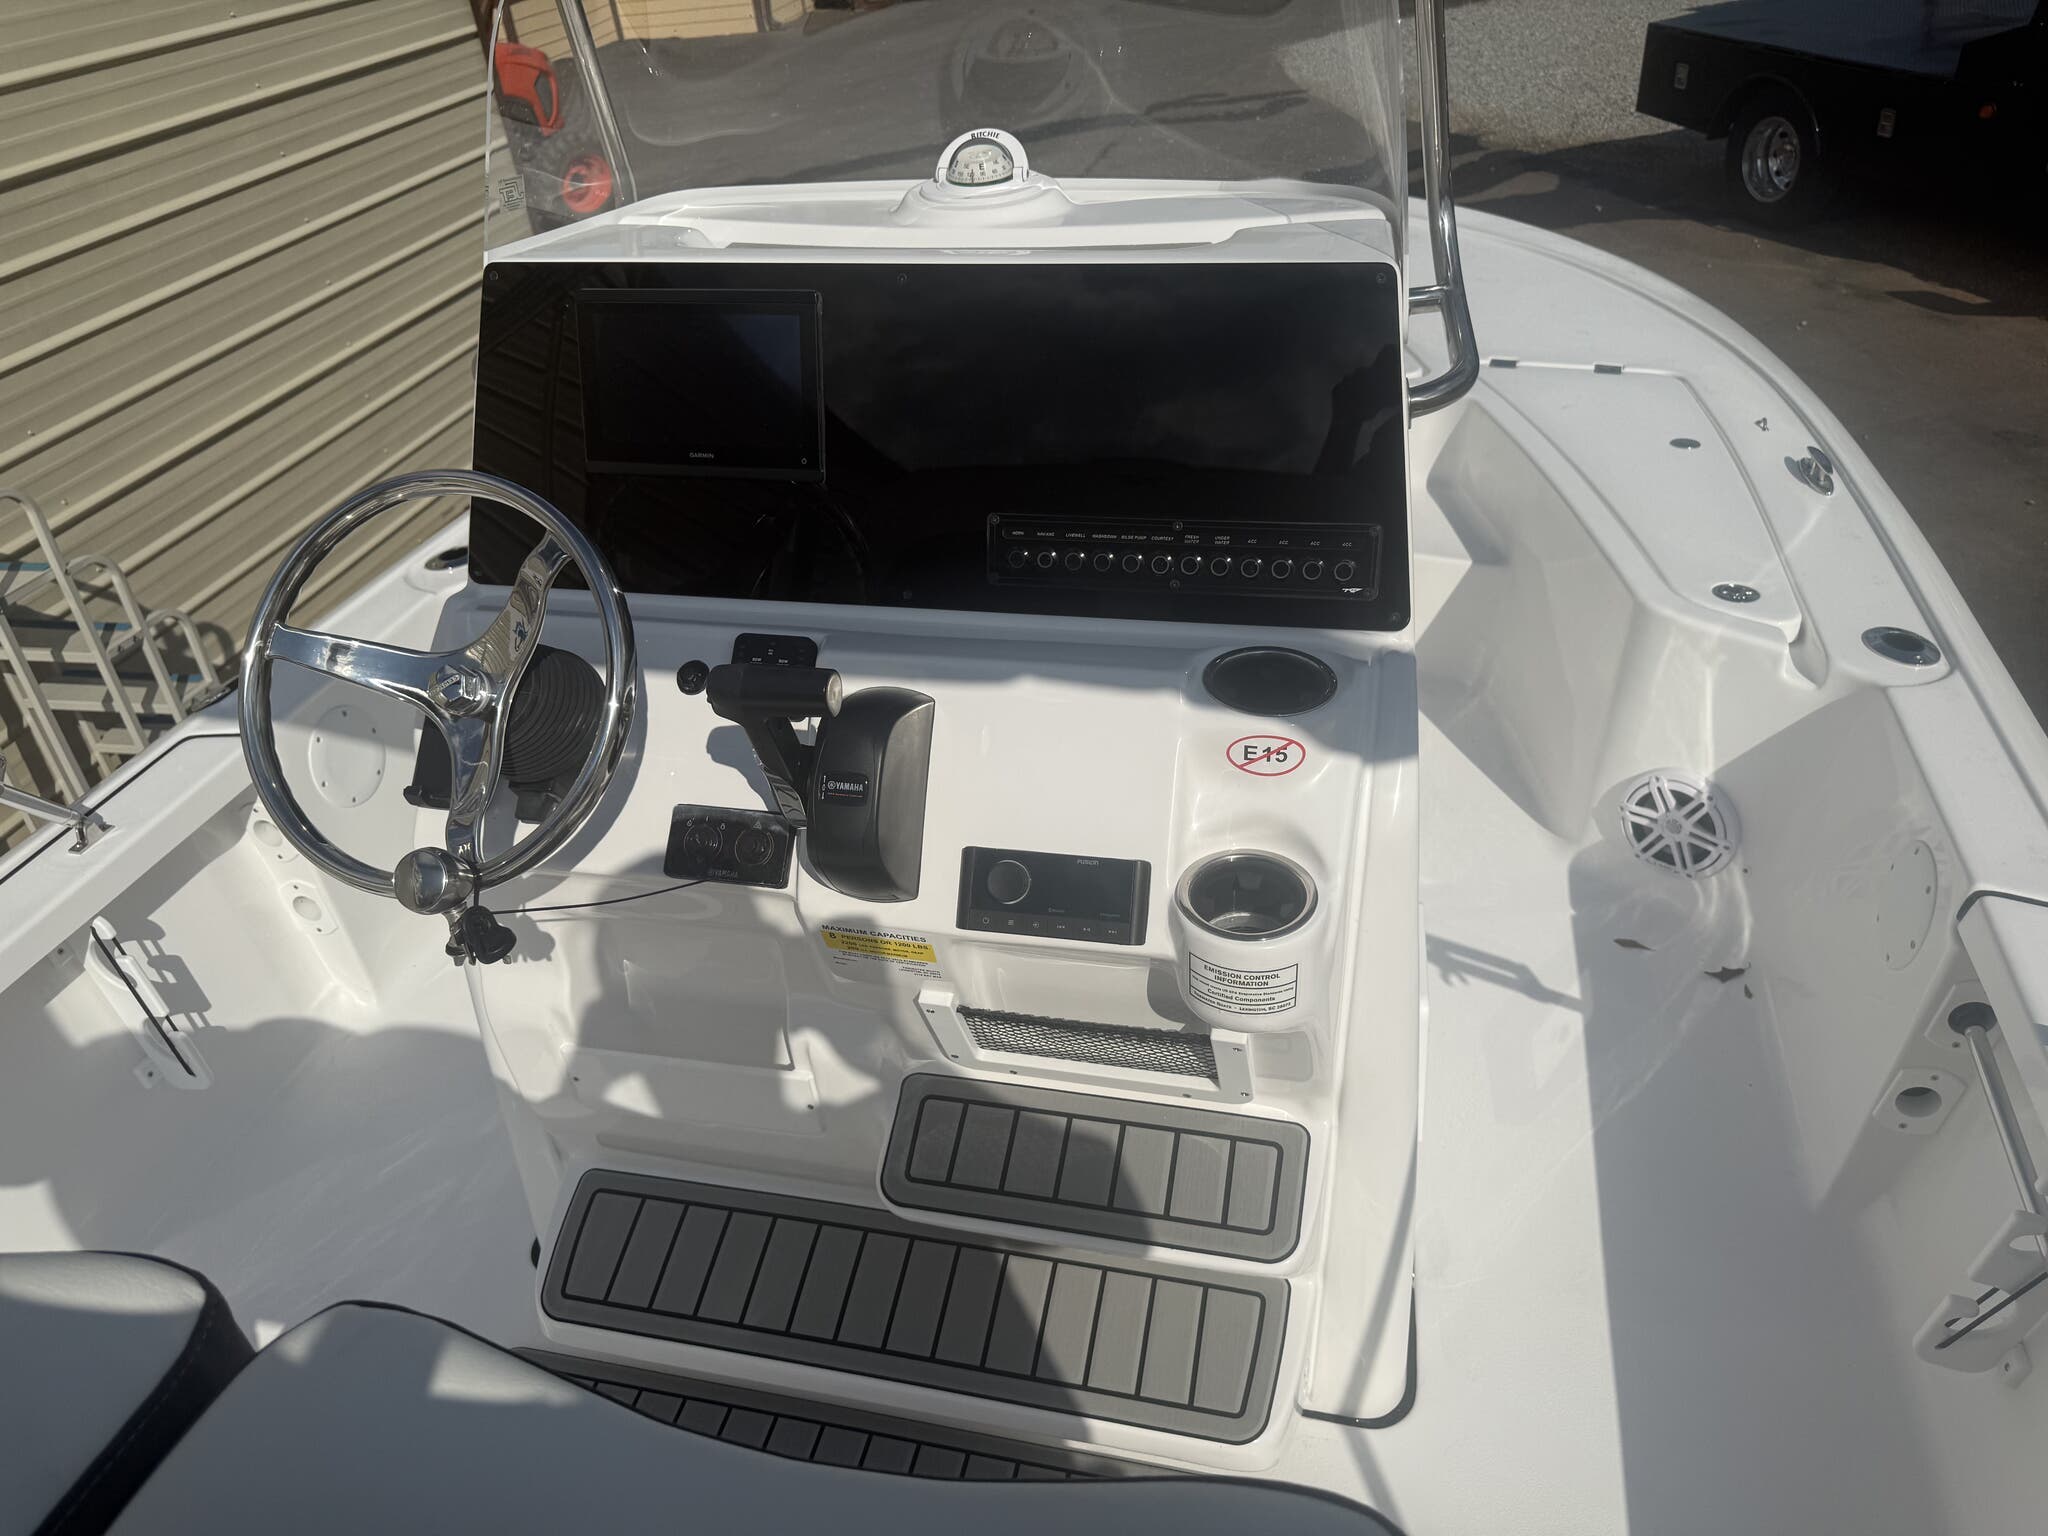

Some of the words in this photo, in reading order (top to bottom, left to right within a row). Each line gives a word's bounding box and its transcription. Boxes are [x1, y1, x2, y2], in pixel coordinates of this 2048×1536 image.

[970, 130, 1000, 140] RITCHIE
[1244, 745, 1288, 763] E15
[836, 781, 864, 792] YAMAHA
[822, 924, 868, 935] MAXIMUM
[869, 931, 927, 942] CAPACITIES
[840, 935, 879, 944] PERSONS
[1204, 964, 1242, 979] EMISSION
[1214, 975, 1269, 986] INFORMATION
[1207, 988, 1233, 1000] Certified
